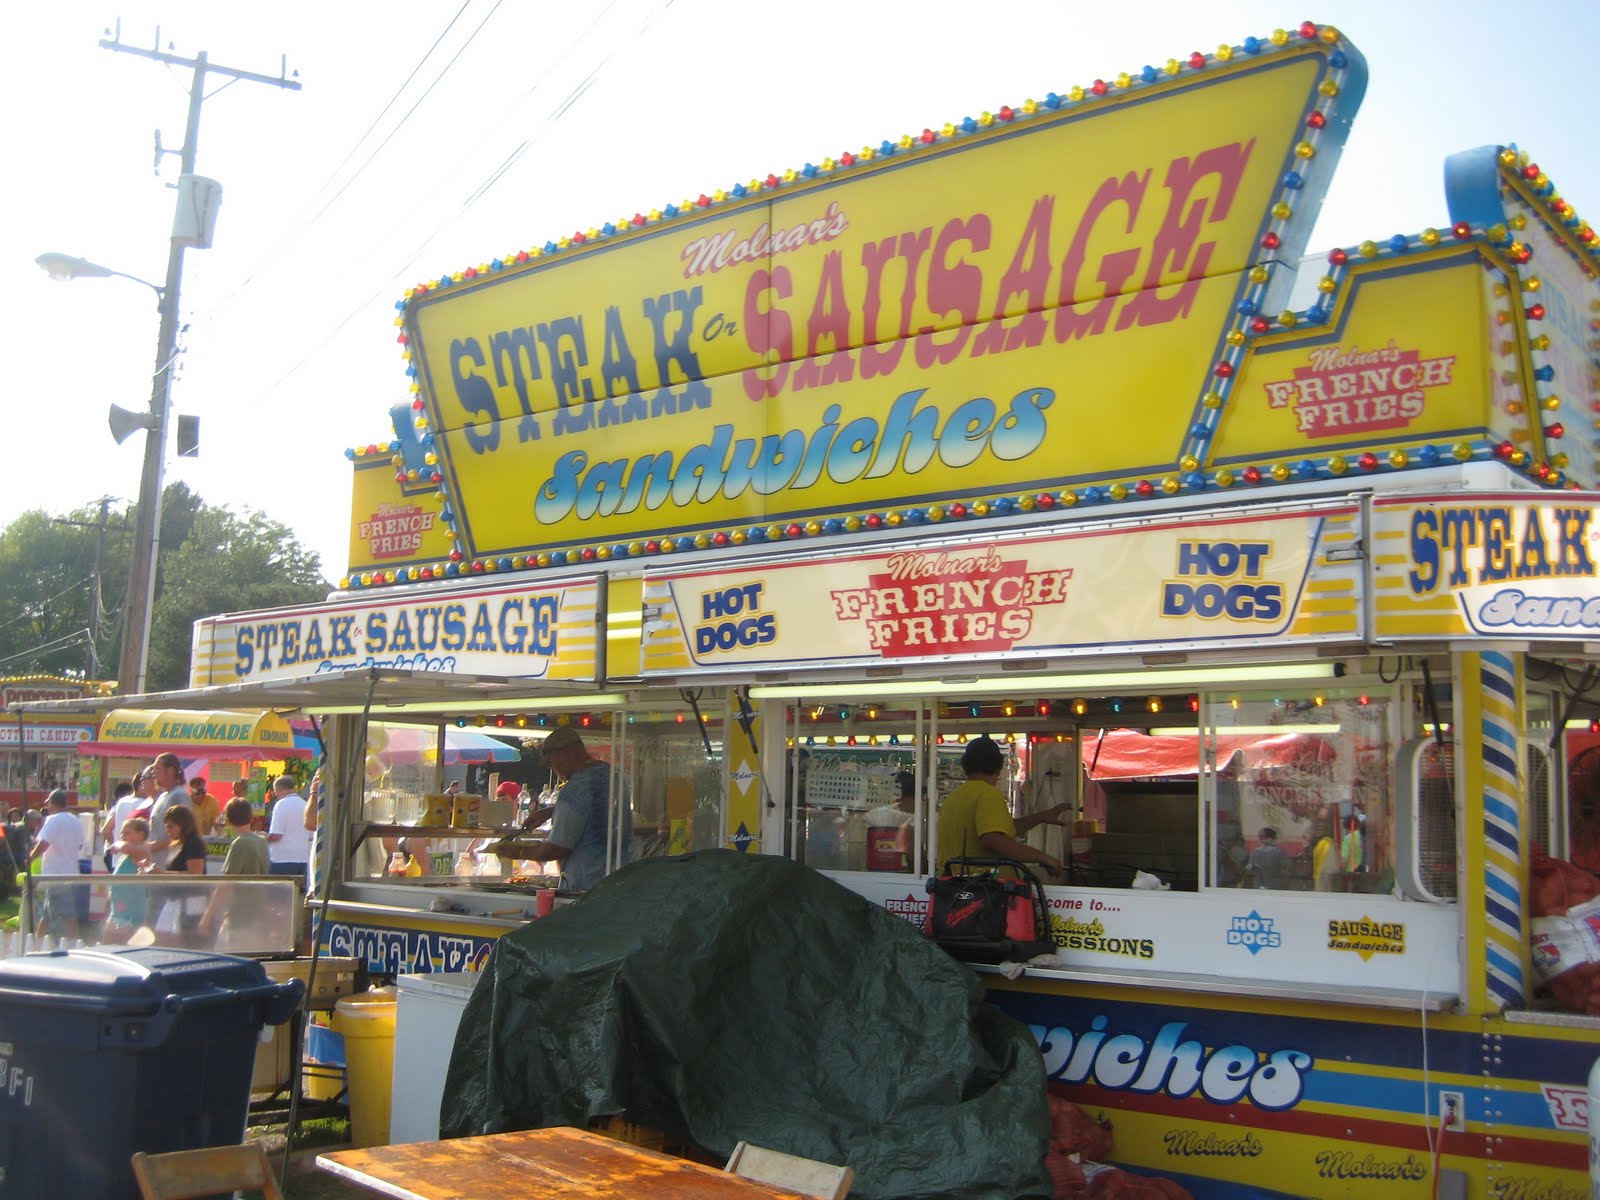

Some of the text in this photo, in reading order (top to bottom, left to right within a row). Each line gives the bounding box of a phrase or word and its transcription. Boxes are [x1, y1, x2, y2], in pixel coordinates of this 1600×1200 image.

[681, 201, 848, 279] Molnar's
[450, 137, 1257, 455] STEAK Or SAUSAGE
[1309, 339, 1401, 372] Molnar's
[1265, 357, 1456, 408] FRENCH
[1294, 390, 1424, 431] FRIES
[534, 387, 1055, 524] Sandwiches
[359, 513, 435, 538] FRENCH
[370, 534, 421, 554] FRIES
[1178, 542, 1270, 578] HOT
[1409, 506, 1594, 597] STEAK
[886, 544, 1003, 581] Molnar's
[703, 582, 763, 619] HOT
[831, 569, 1073, 620] FRENCH
[1163, 582, 1283, 620] DOGS
[235, 614, 357, 676] STEAK
[365, 594, 559, 657] SAUSAGE
[695, 614, 776, 653] DOGS
[867, 607, 1033, 650] FRIES
[0, 728, 78, 741] OTTN CANDY
[159, 722, 252, 740] LEMONADE
[1036, 897, 1083, 910] come
[1228, 931, 1280, 946] DOGS
[1233, 918, 1273, 931] HOT
[1328, 920, 1403, 940] SAUSAGE
[1053, 934, 1154, 958] ESSIONS
[1328, 939, 1404, 953] Sandwiches
[1164, 1130, 1263, 1157] Molnar's
[1316, 1151, 1427, 1181] Molnar's
